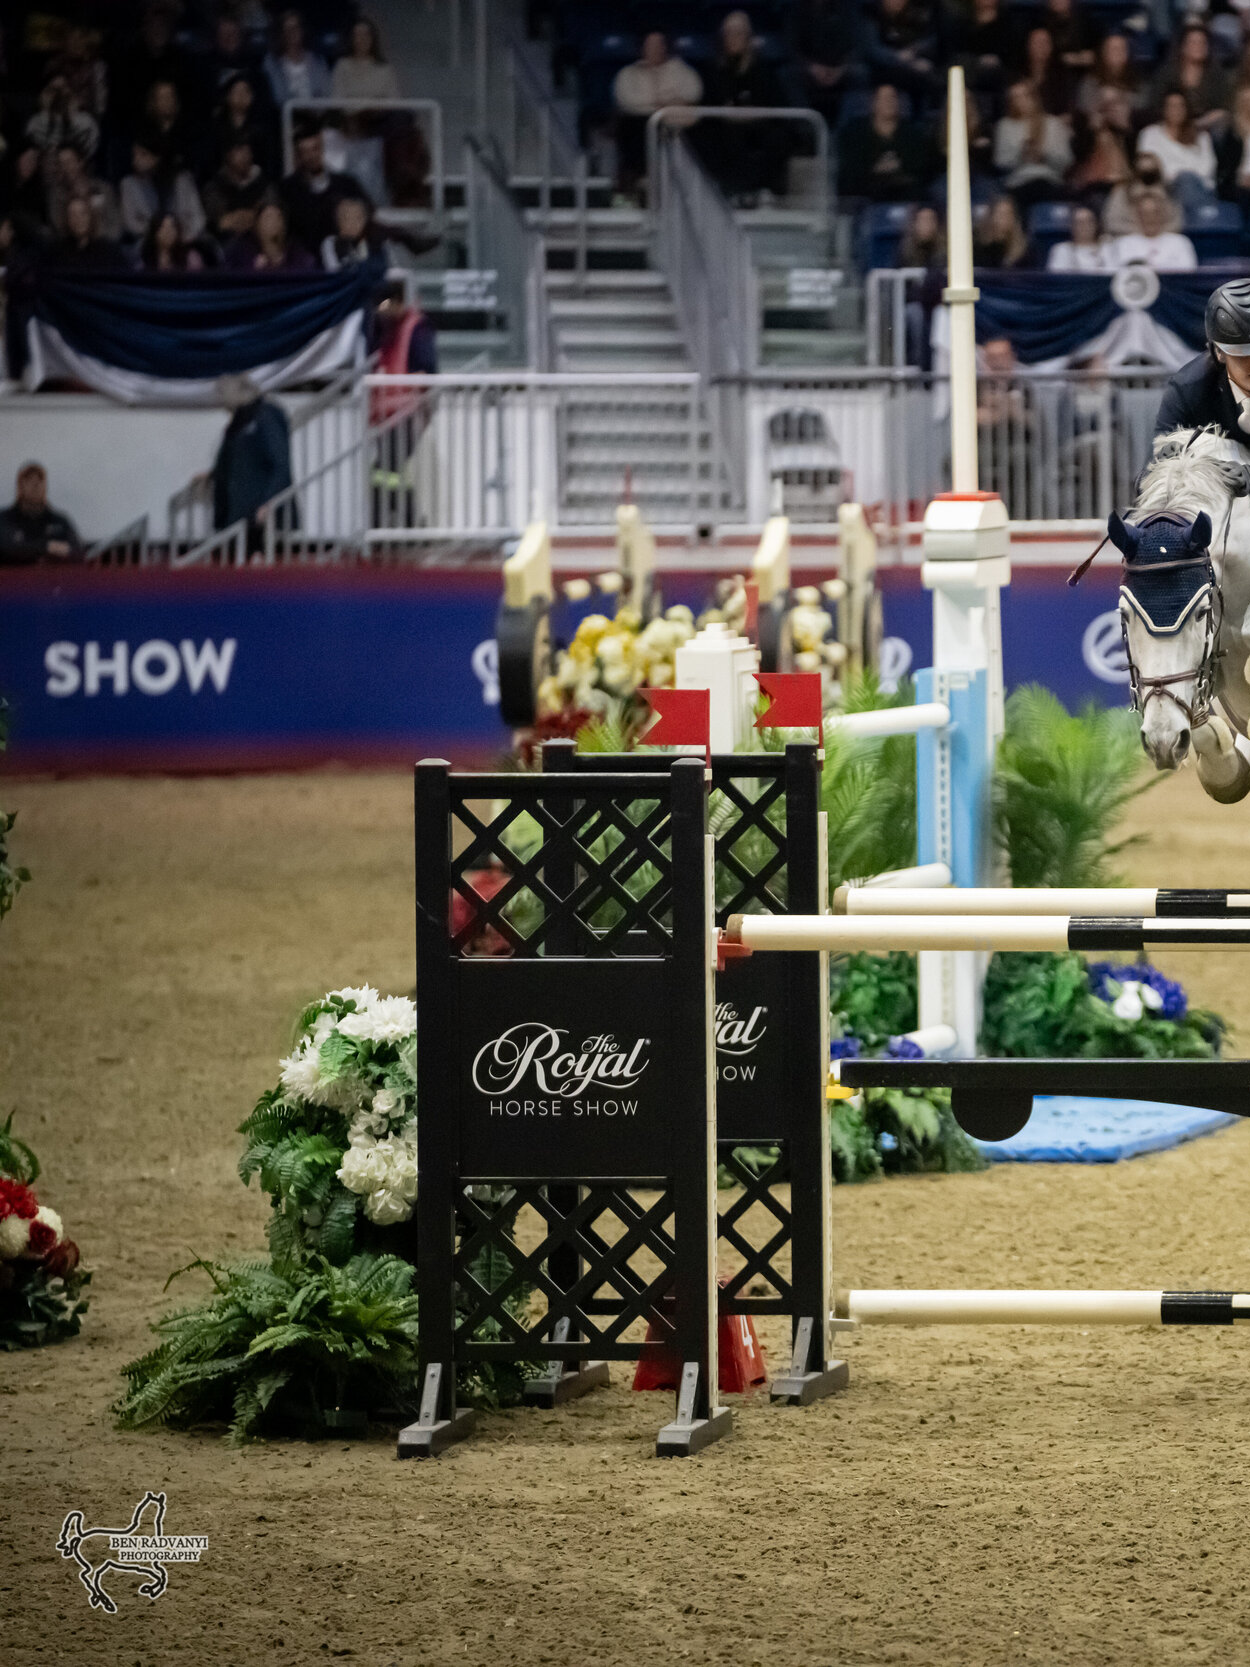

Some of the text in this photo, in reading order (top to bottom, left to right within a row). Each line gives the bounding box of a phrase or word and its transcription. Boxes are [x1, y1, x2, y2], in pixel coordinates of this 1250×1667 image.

[44, 638, 237, 697] SHOW
[472, 1022, 650, 1098] Royal
[581, 1033, 621, 1053] The
[490, 1100, 639, 1116] HORSE SHOW
[739, 1314, 755, 1359] 4
